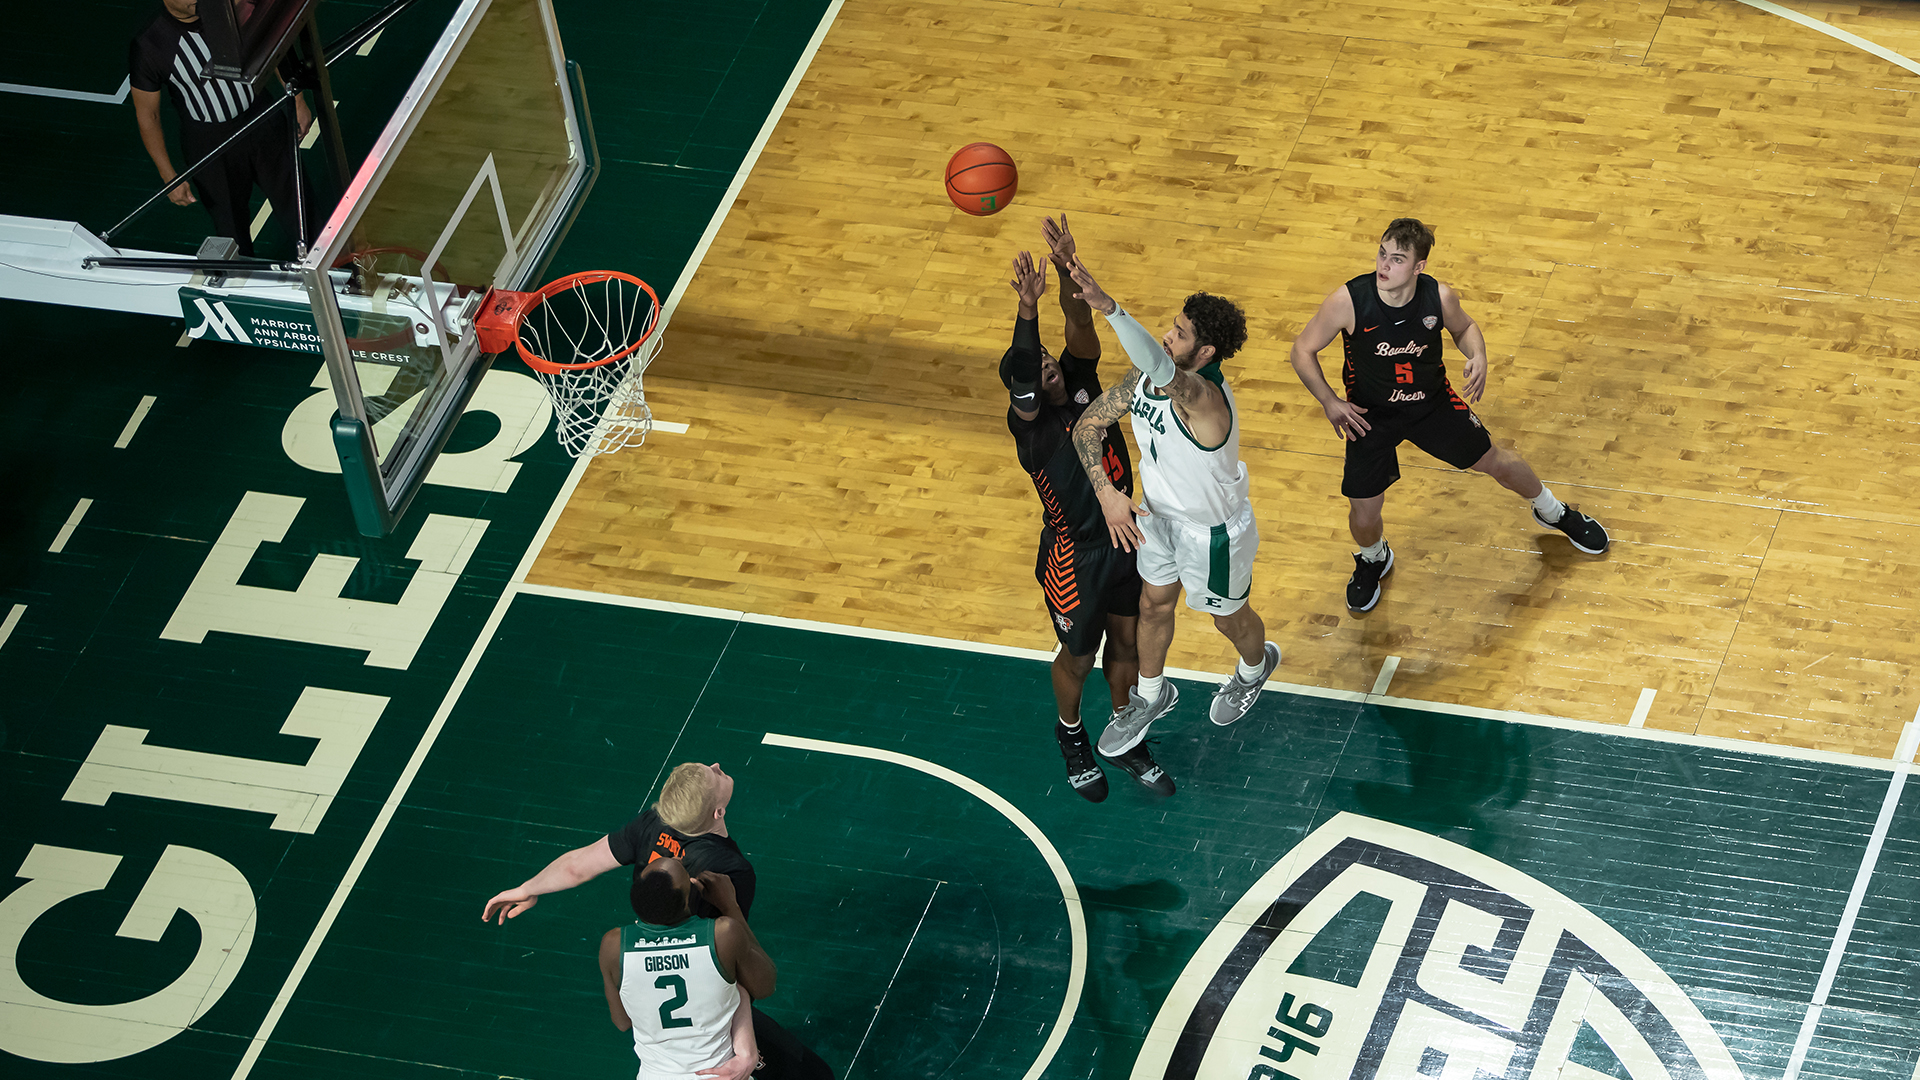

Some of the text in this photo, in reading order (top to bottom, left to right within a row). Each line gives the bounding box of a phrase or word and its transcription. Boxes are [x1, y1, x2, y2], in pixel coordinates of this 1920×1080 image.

[251, 317, 312, 332] MARRIOTT
[254, 328, 279, 338] ANN
[255, 337, 321, 352] YPSILANTI
[371, 352, 410, 363] CREST
[1374, 340, 1429, 357] Bowling
[1395, 362, 1414, 384] 5
[644, 953, 690, 973] GIBSON
[654, 973, 693, 1029] 2
